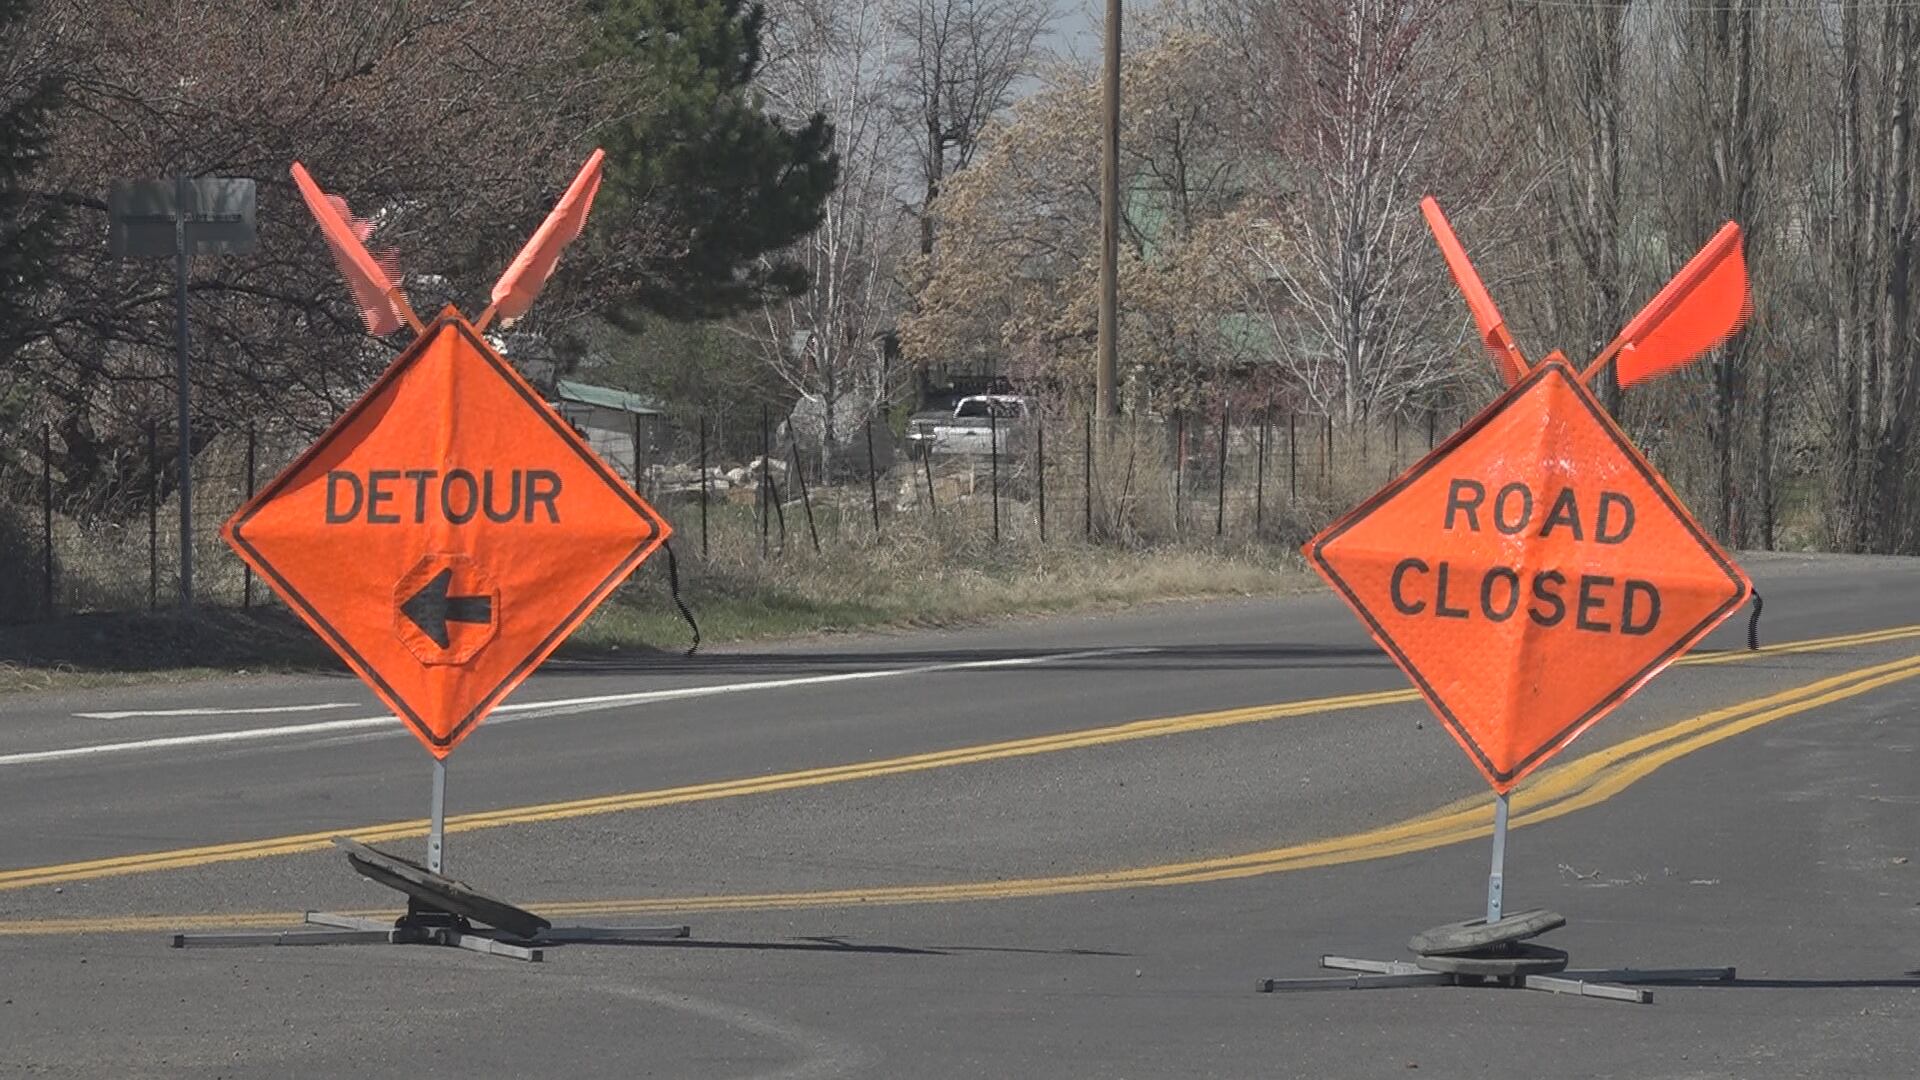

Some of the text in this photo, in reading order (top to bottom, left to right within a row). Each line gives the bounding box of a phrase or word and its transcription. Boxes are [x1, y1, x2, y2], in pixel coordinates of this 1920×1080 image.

[325, 468, 563, 525] DETOUR
[1444, 478, 1636, 545] ROAD
[1389, 557, 1662, 637] CLOSED
